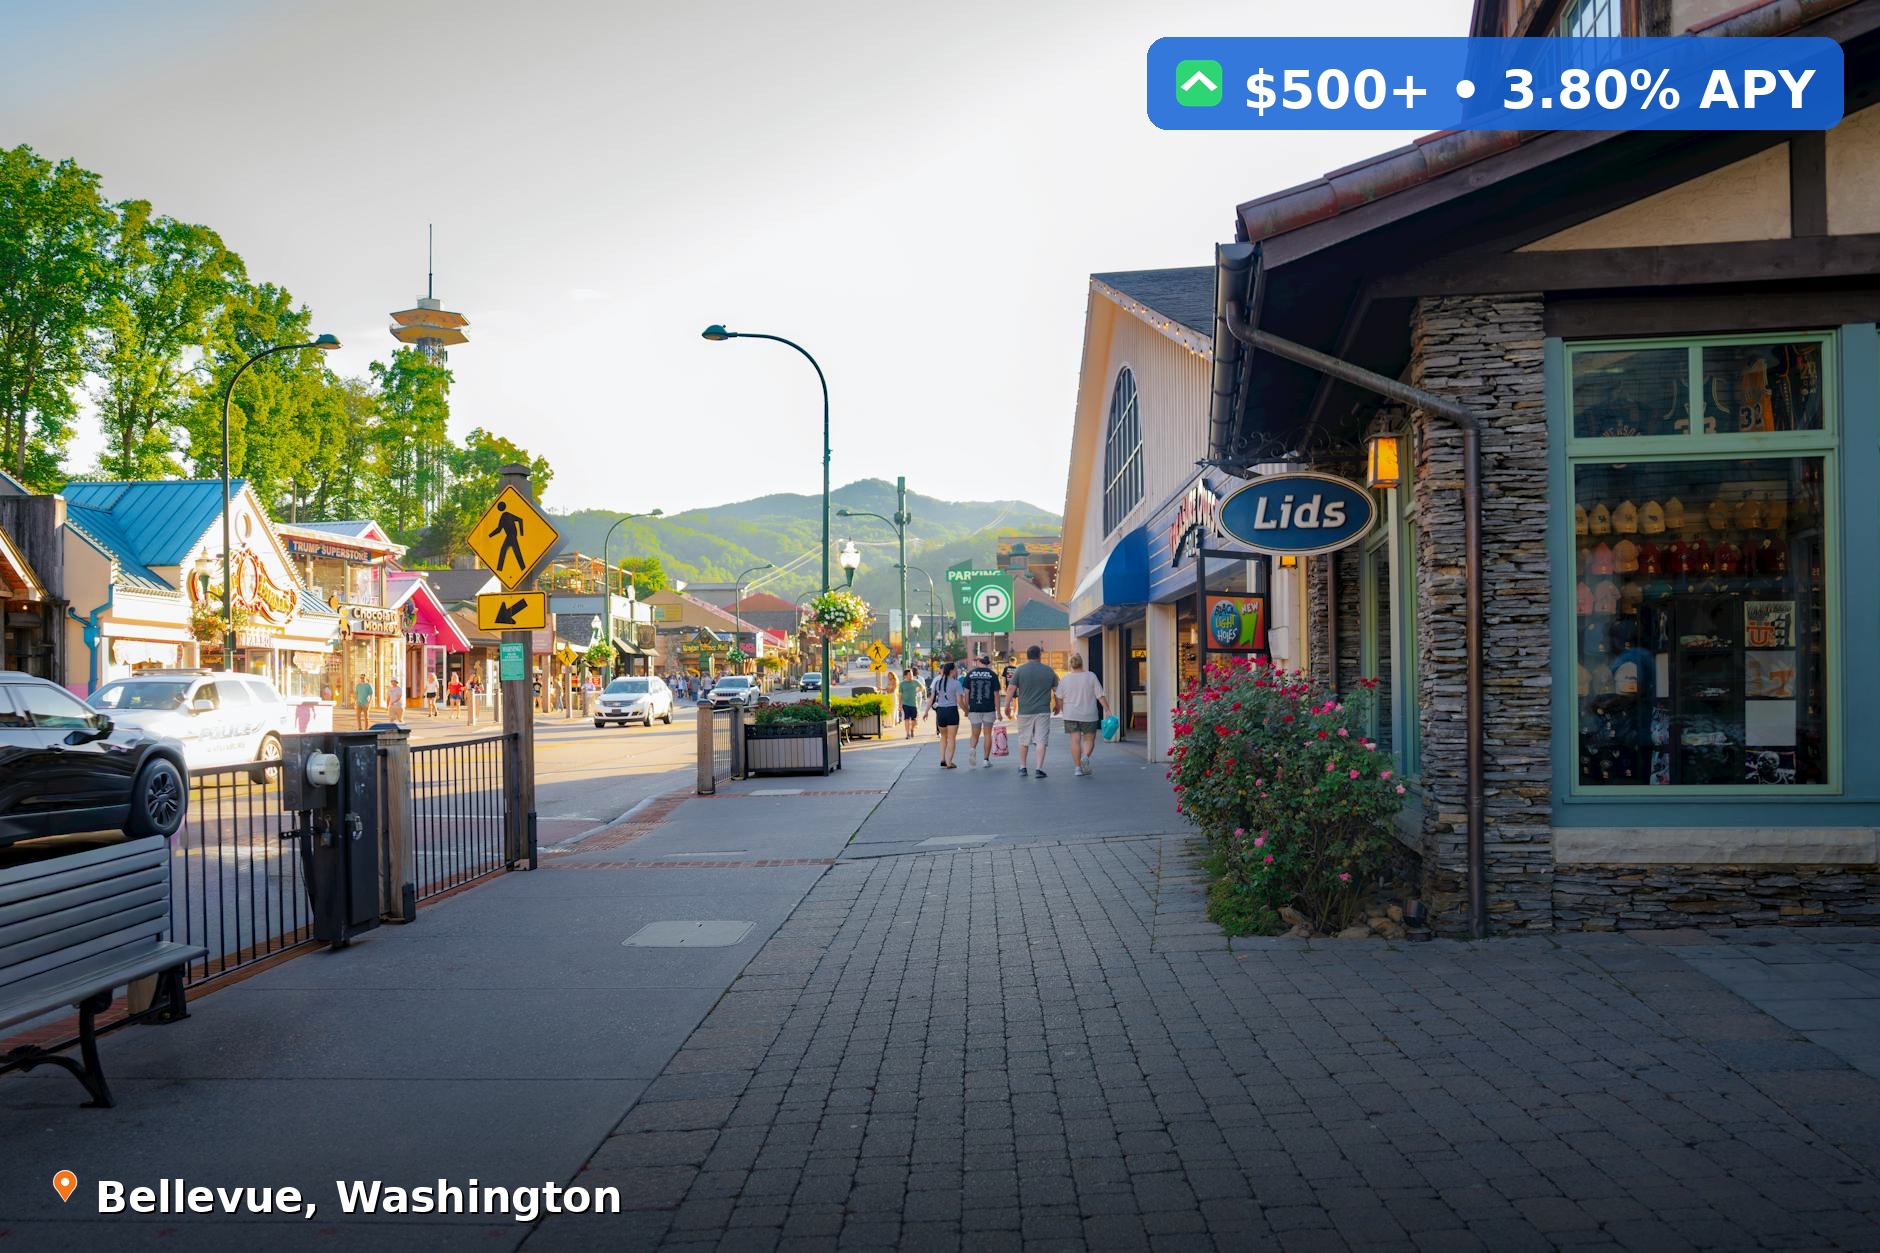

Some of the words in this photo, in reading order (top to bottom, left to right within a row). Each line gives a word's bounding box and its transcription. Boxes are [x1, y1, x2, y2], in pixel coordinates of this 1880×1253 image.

[1253, 494, 1346, 530] Lids
[293, 540, 318, 554] TRUMP
[321, 545, 369, 560] SUPERSTORE
[986, 595, 1000, 613] P
[1214, 603, 1236, 616] BLACK
[1241, 601, 1259, 615] NEW
[362, 621, 398, 634] Monkey
[1215, 613, 1236, 628] LIGHT
[1217, 627, 1238, 643] HOLES
